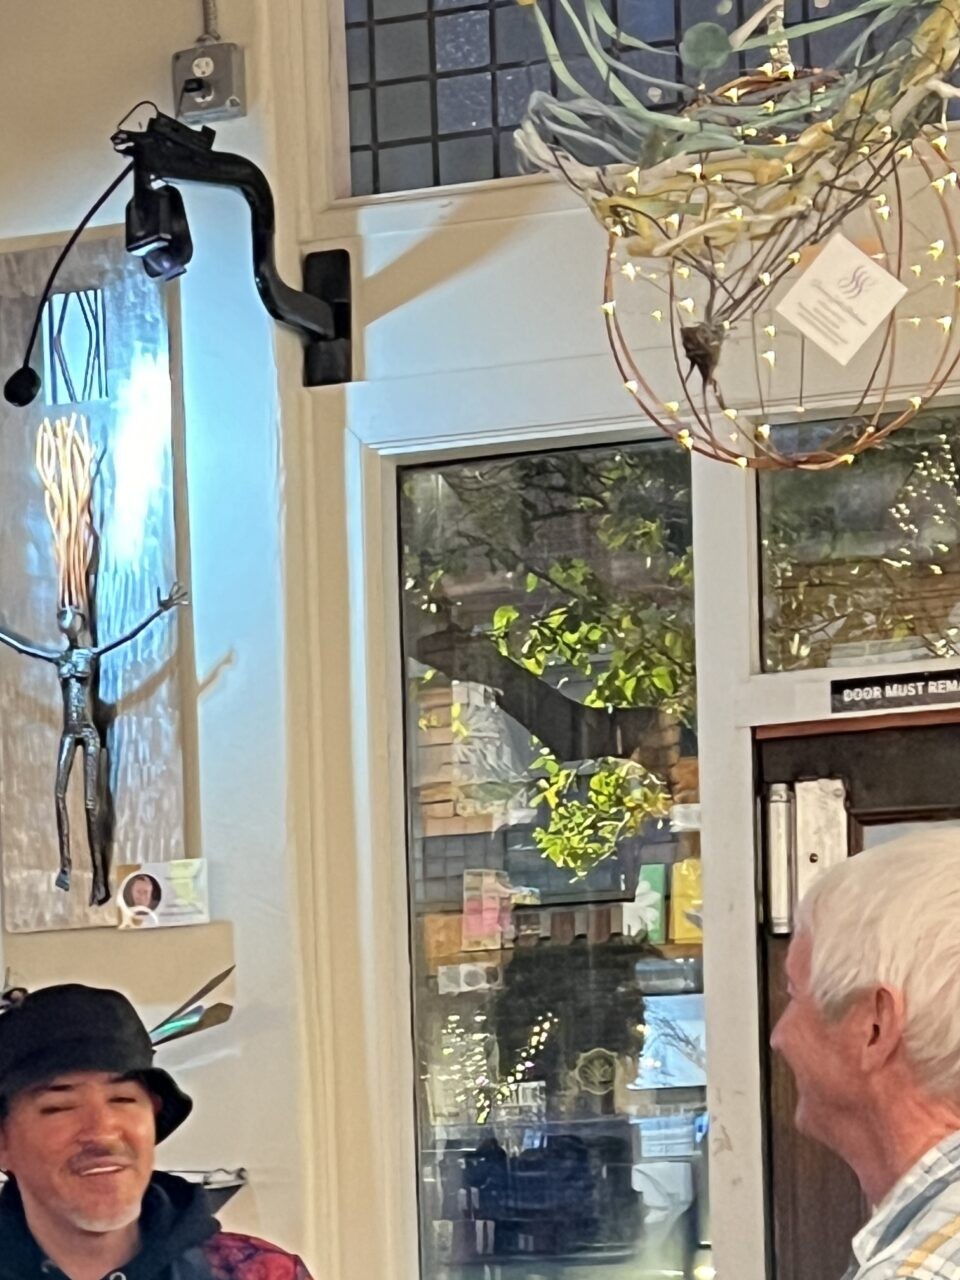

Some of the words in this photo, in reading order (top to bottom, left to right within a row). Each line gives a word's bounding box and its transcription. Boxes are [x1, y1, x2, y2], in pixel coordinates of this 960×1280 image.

[843, 686, 882, 702] DOOR
[884, 682, 925, 698] MUST
[927, 679, 960, 694] REM
